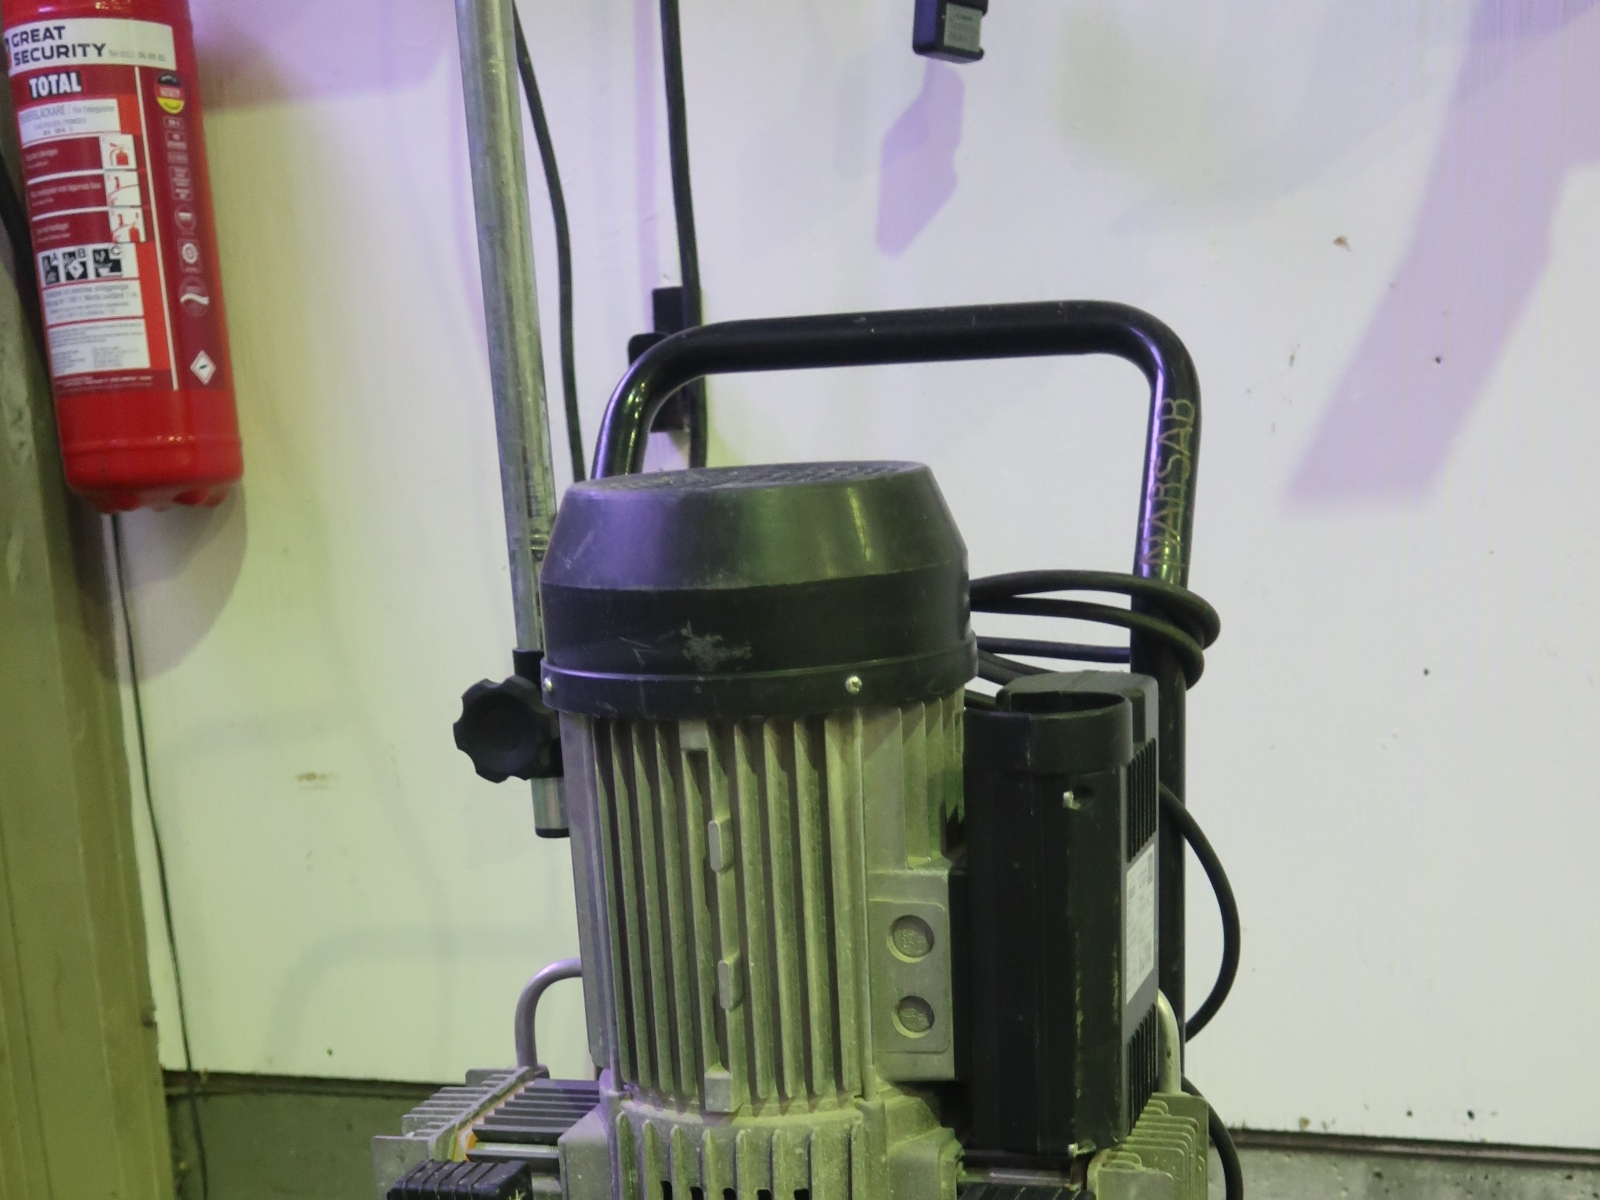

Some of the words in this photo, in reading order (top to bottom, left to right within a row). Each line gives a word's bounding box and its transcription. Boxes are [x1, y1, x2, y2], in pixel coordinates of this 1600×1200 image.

[12, 25, 66, 48] GREAT
[13, 42, 107, 66] SECURITY
[29, 72, 82, 98] TOTAL
